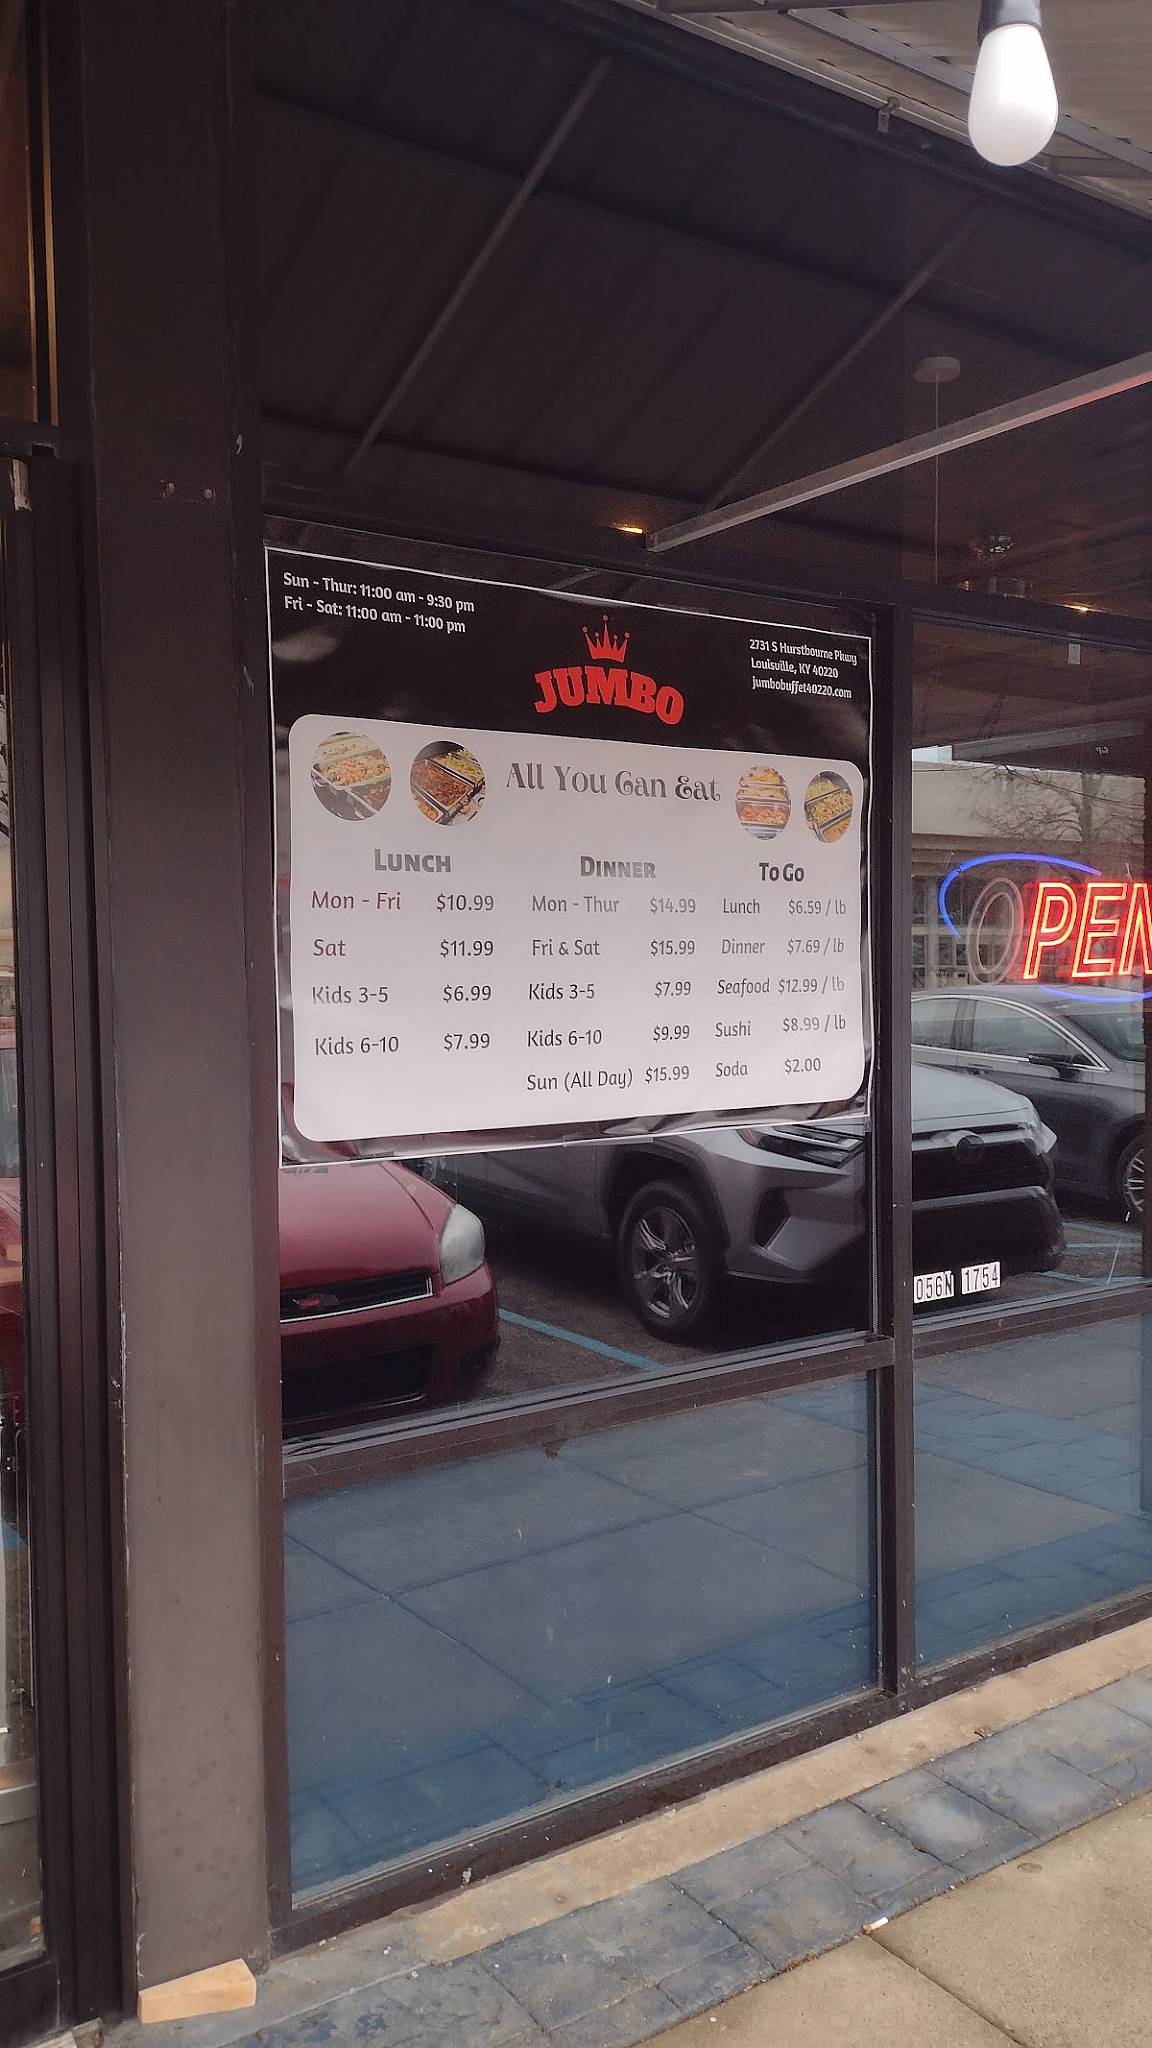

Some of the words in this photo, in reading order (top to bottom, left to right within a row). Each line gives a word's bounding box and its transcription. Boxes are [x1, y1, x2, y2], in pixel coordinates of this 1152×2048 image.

[283, 572, 310, 588] Sun
[322, 577, 357, 595] Thur:
[360, 584, 392, 600] 11:00
[396, 591, 416, 603] am
[427, 594, 452, 609] 9:30
[456, 601, 475, 614] pm
[284, 596, 303, 611] Fri
[316, 600, 343, 616] Sat:
[346, 605, 378, 621] 11:00
[381, 611, 402, 624] am
[414, 614, 444, 630] 11:00
[447, 621, 466, 634] pm
[749, 639, 770, 652] 2731
[772, 641, 778, 652] S
[779, 642, 834, 660] Hurstbourne
[834, 650, 858, 666] Pkwy
[751, 657, 797, 674] Louisville,
[799, 662, 811, 675] KY
[812, 664, 839, 678] 40220
[534, 665, 685, 725] JUMBO
[752, 676, 853, 699] jumbobuffet40220.com
[506, 762, 545, 789] All
[554, 765, 608, 794] You
[614, 770, 667, 798] Can
[675, 775, 721, 801] Eat
[374, 849, 452, 872] LUNCH
[580, 856, 657, 878] DINNER
[759, 863, 780, 881] To
[782, 863, 805, 882] Go
[311, 891, 354, 909] Mon
[377, 893, 401, 910] Fri
[436, 894, 494, 912] $10.99
[532, 895, 567, 912] Mon
[584, 896, 620, 913] Thur
[650, 897, 696, 914] $14.99
[723, 899, 761, 914] Lunch
[788, 899, 822, 915] $6.59
[835, 900, 847, 915] lb
[313, 939, 346, 956] Sat
[440, 940, 494, 958] $11.99
[532, 940, 553, 956] Fri
[558, 941, 569, 955] &
[574, 940, 600, 956] Sat
[650, 940, 696, 956] $15.99
[721, 939, 766, 954] Dinner
[787, 938, 820, 954] $7.69
[833, 938, 845, 953] lb
[312, 986, 352, 1004] Kids
[358, 987, 389, 1003] 3-5
[443, 985, 492, 1003] $6.99
[529, 983, 564, 1000] Kids
[569, 984, 595, 998] 3-5
[655, 981, 692, 997] $7.99
[717, 978, 770, 997] Seafood
[778, 978, 818, 994] $12.99
[832, 976, 845, 992] lb
[527, 1029, 562, 1047] Kids
[568, 1029, 602, 1046] 6-10
[653, 1025, 690, 1041] $9.99
[715, 1021, 751, 1037] Sushi
[783, 1017, 820, 1033] $8.99
[834, 1014, 846, 1030] lb
[315, 1037, 353, 1055] Kids
[360, 1036, 399, 1054] 6-10
[443, 1033, 491, 1052] $7.99
[715, 1061, 748, 1078] Soda
[784, 1057, 821, 1073] $2.00
[527, 1075, 558, 1090] Sun
[564, 1071, 593, 1092] (All
[598, 1068, 633, 1090] Day)
[645, 1066, 690, 1084] $15.99
[964, 1264, 998, 1292] 1754
